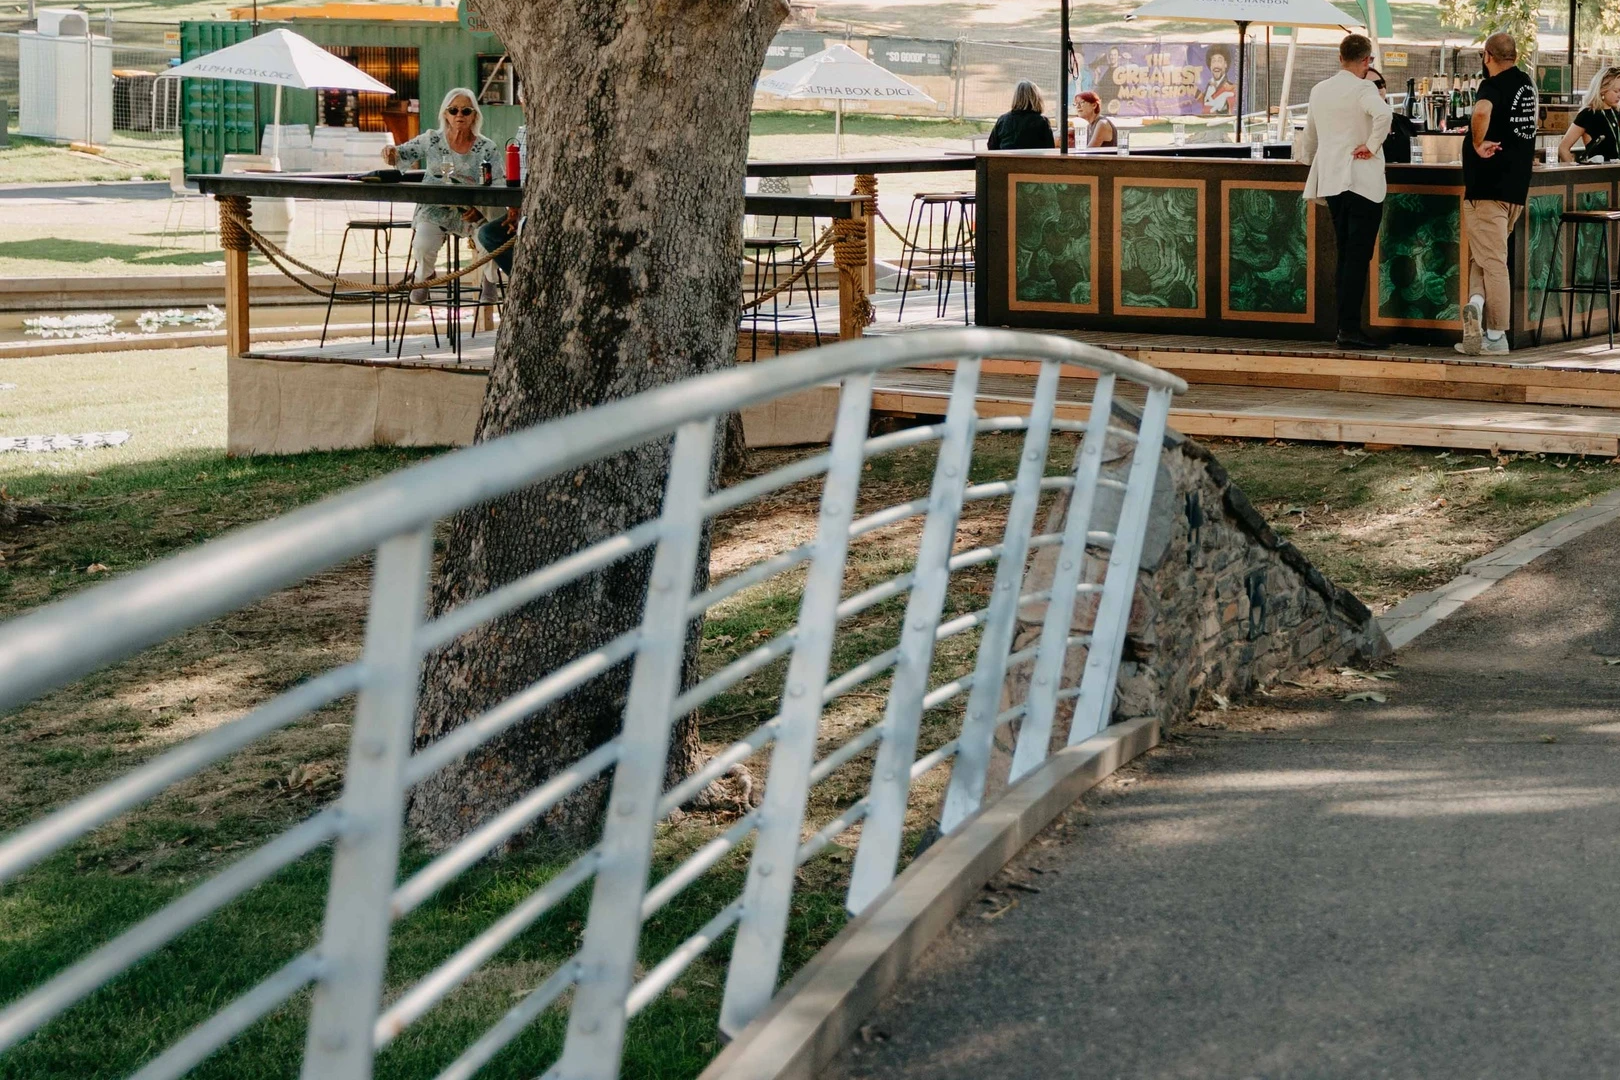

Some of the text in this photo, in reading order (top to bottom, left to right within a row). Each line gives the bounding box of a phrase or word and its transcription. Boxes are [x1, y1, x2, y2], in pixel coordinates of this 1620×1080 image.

[1145, 52, 1171, 67] THE
[193, 64, 233, 74] ALPHA
[234, 68, 259, 77] BOX
[1112, 64, 1203, 87] GREATEST
[801, 85, 842, 96] ALPHA
[845, 87, 871, 97] BOX
[873, 87, 884, 97] &
[1117, 85, 1198, 100] MAGIC SHOW
